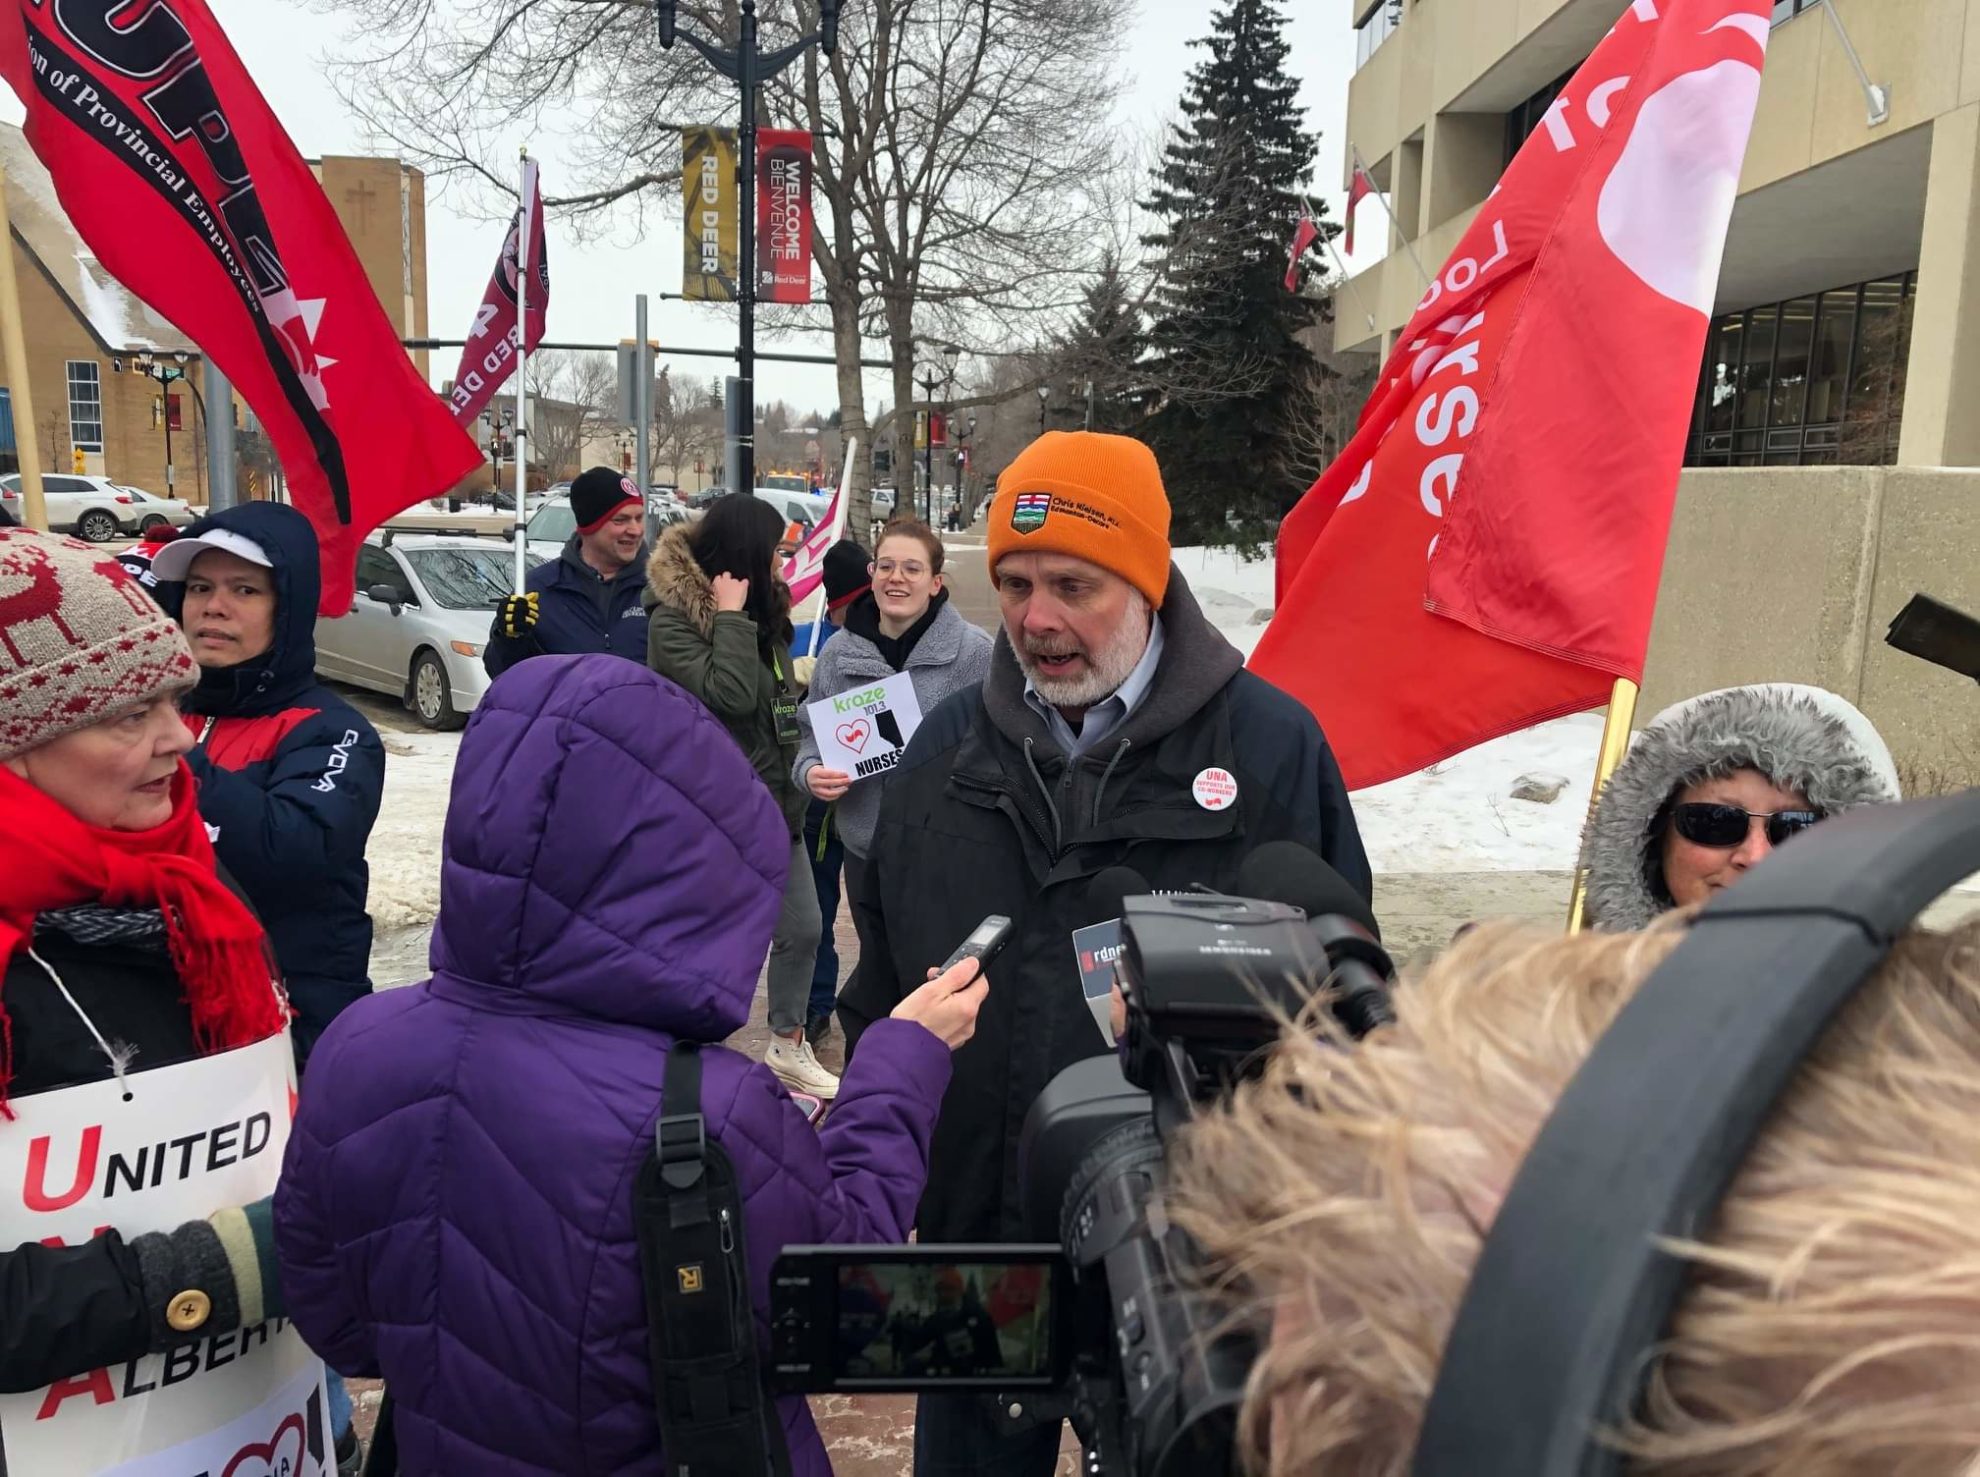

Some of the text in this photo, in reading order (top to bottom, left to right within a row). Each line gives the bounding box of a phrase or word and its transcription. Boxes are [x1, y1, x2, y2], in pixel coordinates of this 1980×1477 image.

[50, 72, 80, 95] of
[72, 83, 187, 192] Provincial
[184, 192, 259, 313] Employees
[702, 156, 719, 273] RED DEER
[770, 158, 785, 260] BIENVENUE
[785, 161, 801, 261] WELCOME
[1053, 498, 1073, 508] Chris
[774, 704, 797, 715] kraze
[832, 686, 886, 714] kraze
[863, 701, 887, 716] 101.3
[855, 748, 903, 777] NURSES
[1207, 771, 1227, 782] UNA
[22, 1111, 272, 1213] UNITED
[35, 1317, 291, 1421] ALBE
